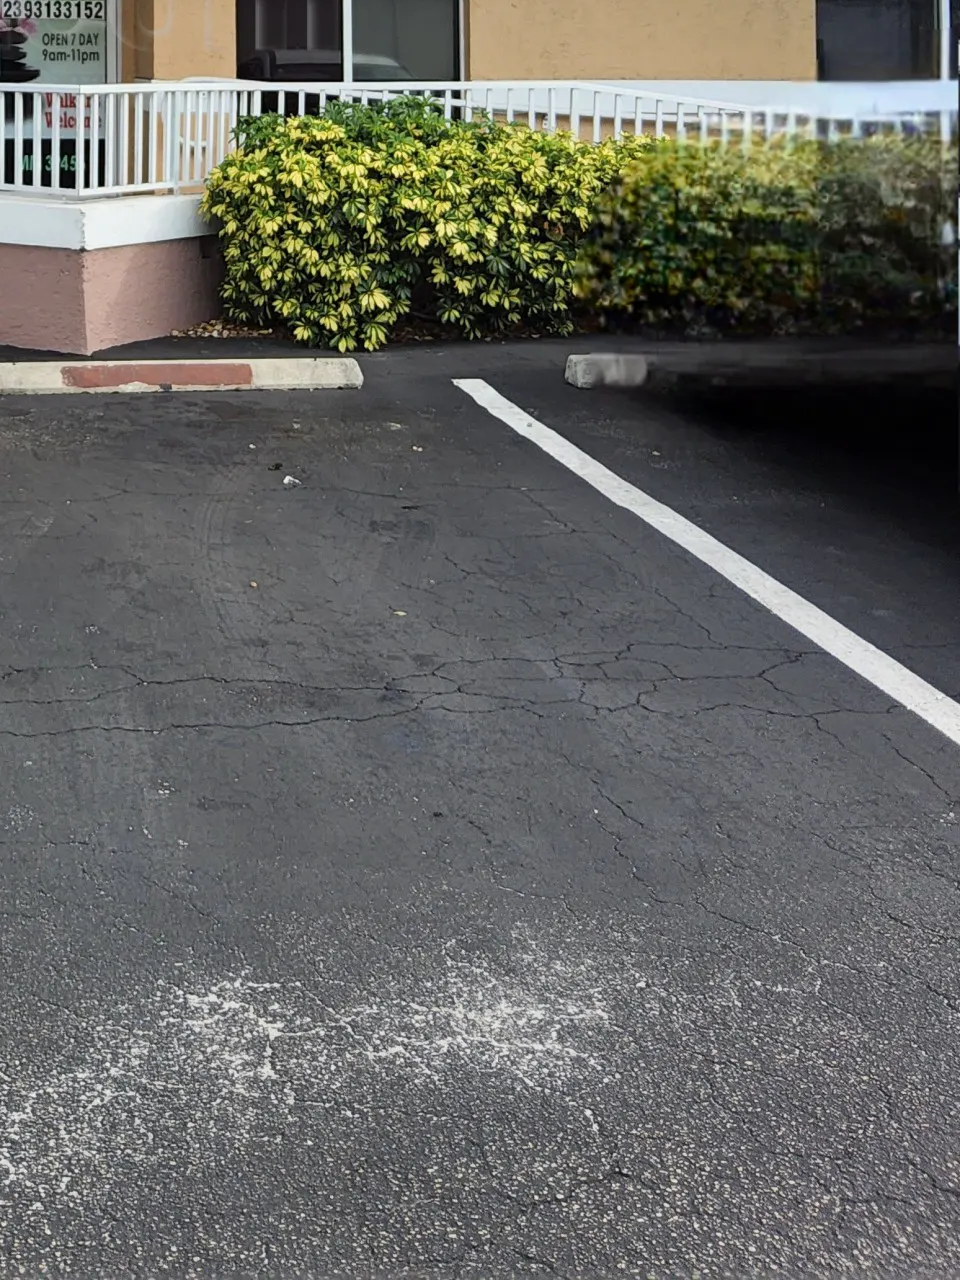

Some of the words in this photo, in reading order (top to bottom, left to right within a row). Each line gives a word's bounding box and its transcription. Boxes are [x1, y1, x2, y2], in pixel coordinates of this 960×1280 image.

[3, 0, 104, 19] 2393133152
[42, 32, 68, 46] OPEN
[70, 32, 77, 46] 7
[78, 32, 100, 46] DAY
[41, 48, 100, 64] 9am-11pm
